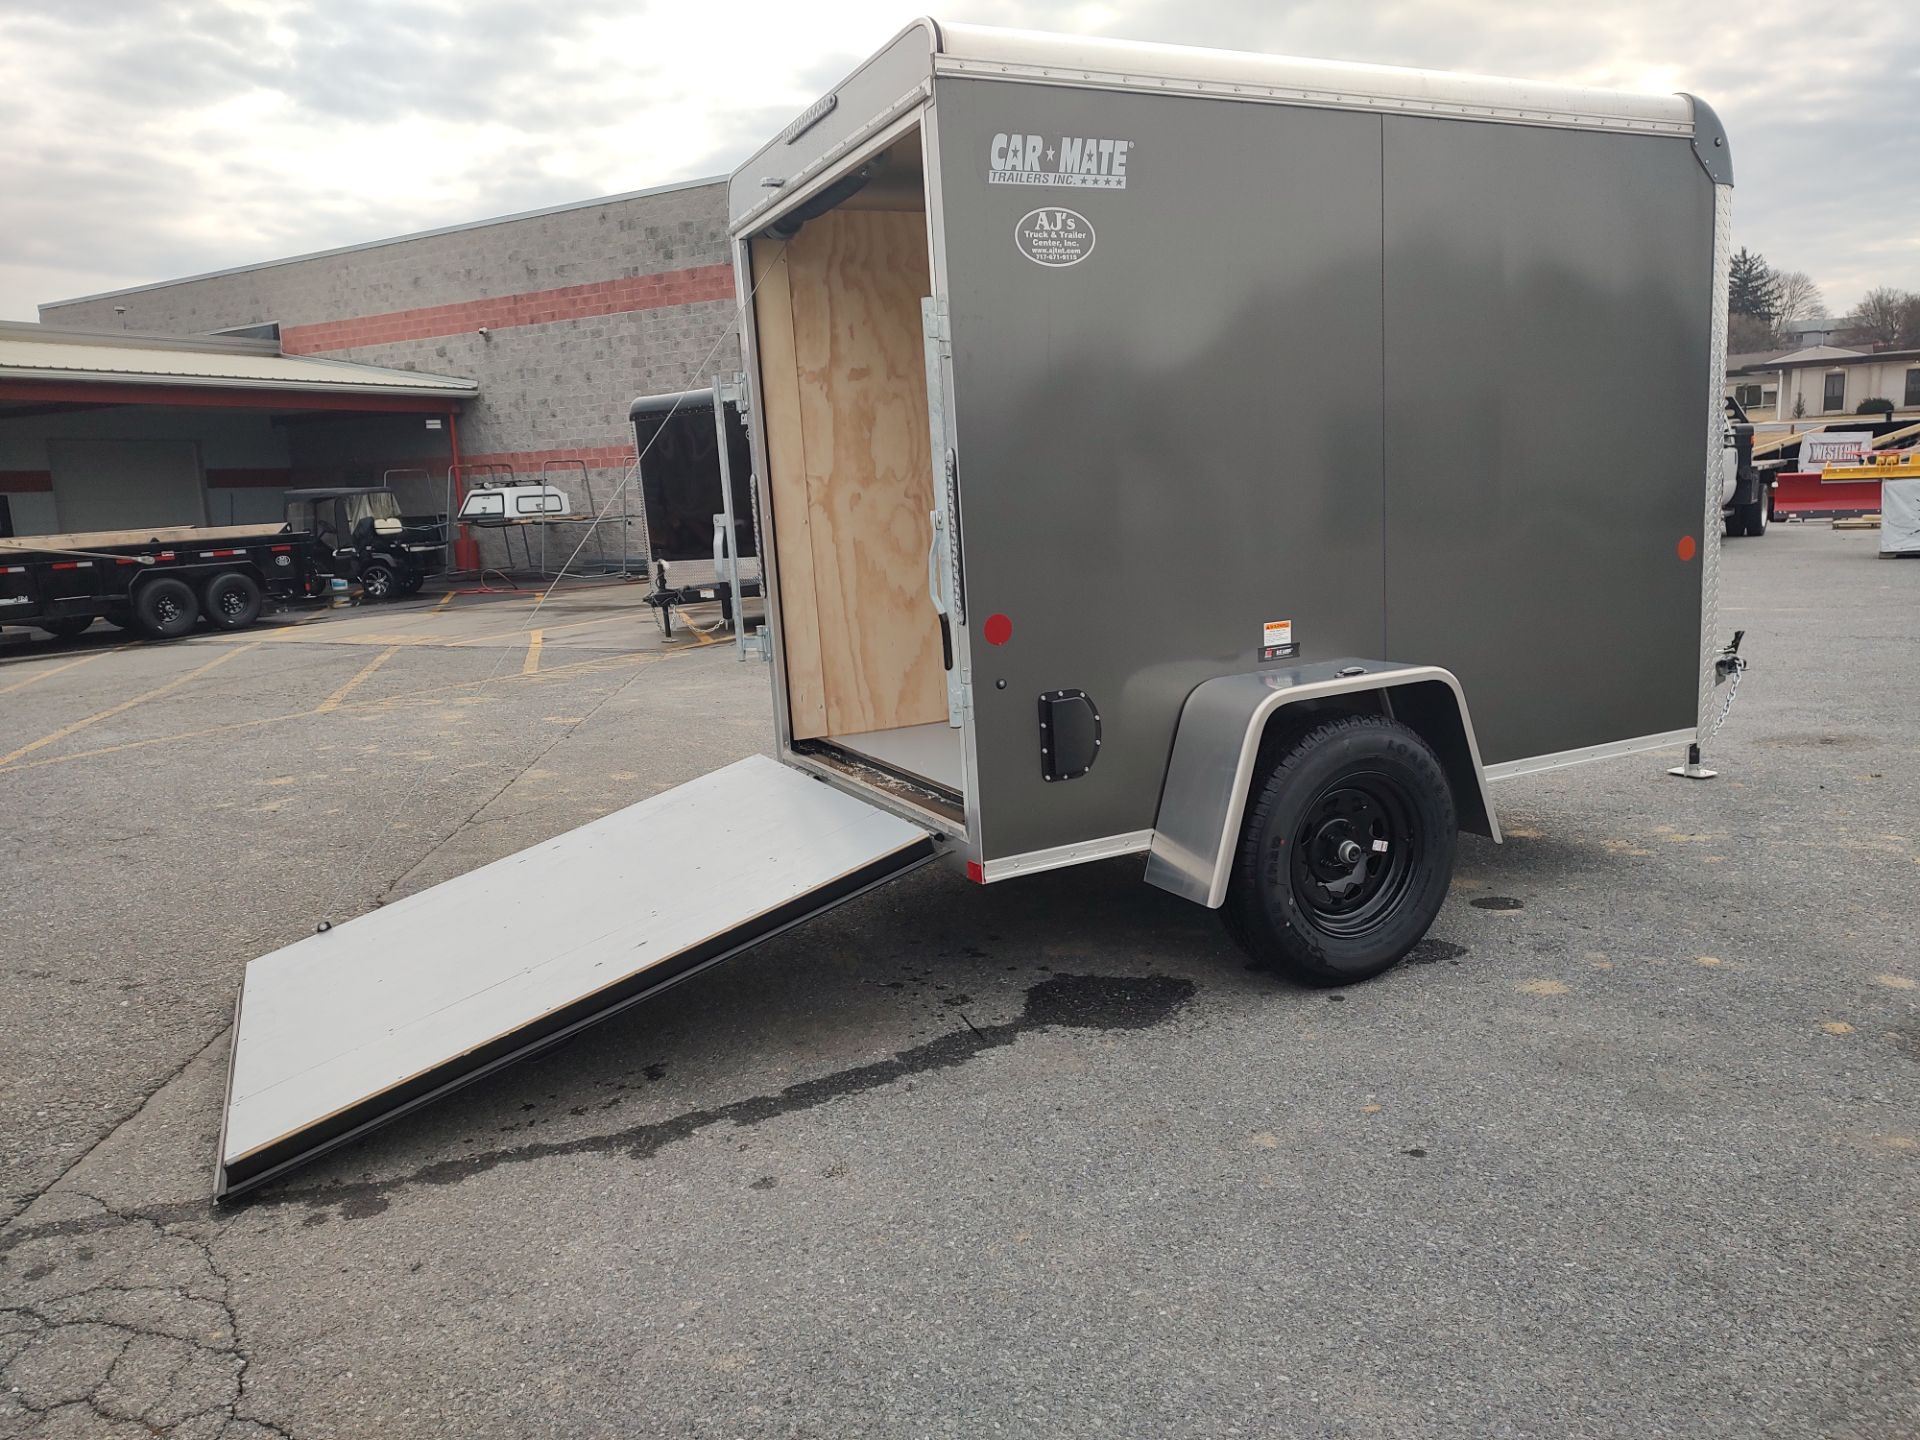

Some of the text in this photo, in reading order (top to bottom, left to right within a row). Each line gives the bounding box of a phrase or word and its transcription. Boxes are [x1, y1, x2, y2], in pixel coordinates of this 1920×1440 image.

[990, 133, 1128, 175] CAR MATE
[991, 171, 1077, 185] TRAILERS INC.
[1035, 212, 1076, 230] AJ's
[1024, 230, 1087, 240] Truck & Trailer
[1032, 239, 1080, 248] Center, Inc.
[1813, 443, 1858, 461] WESTERN
